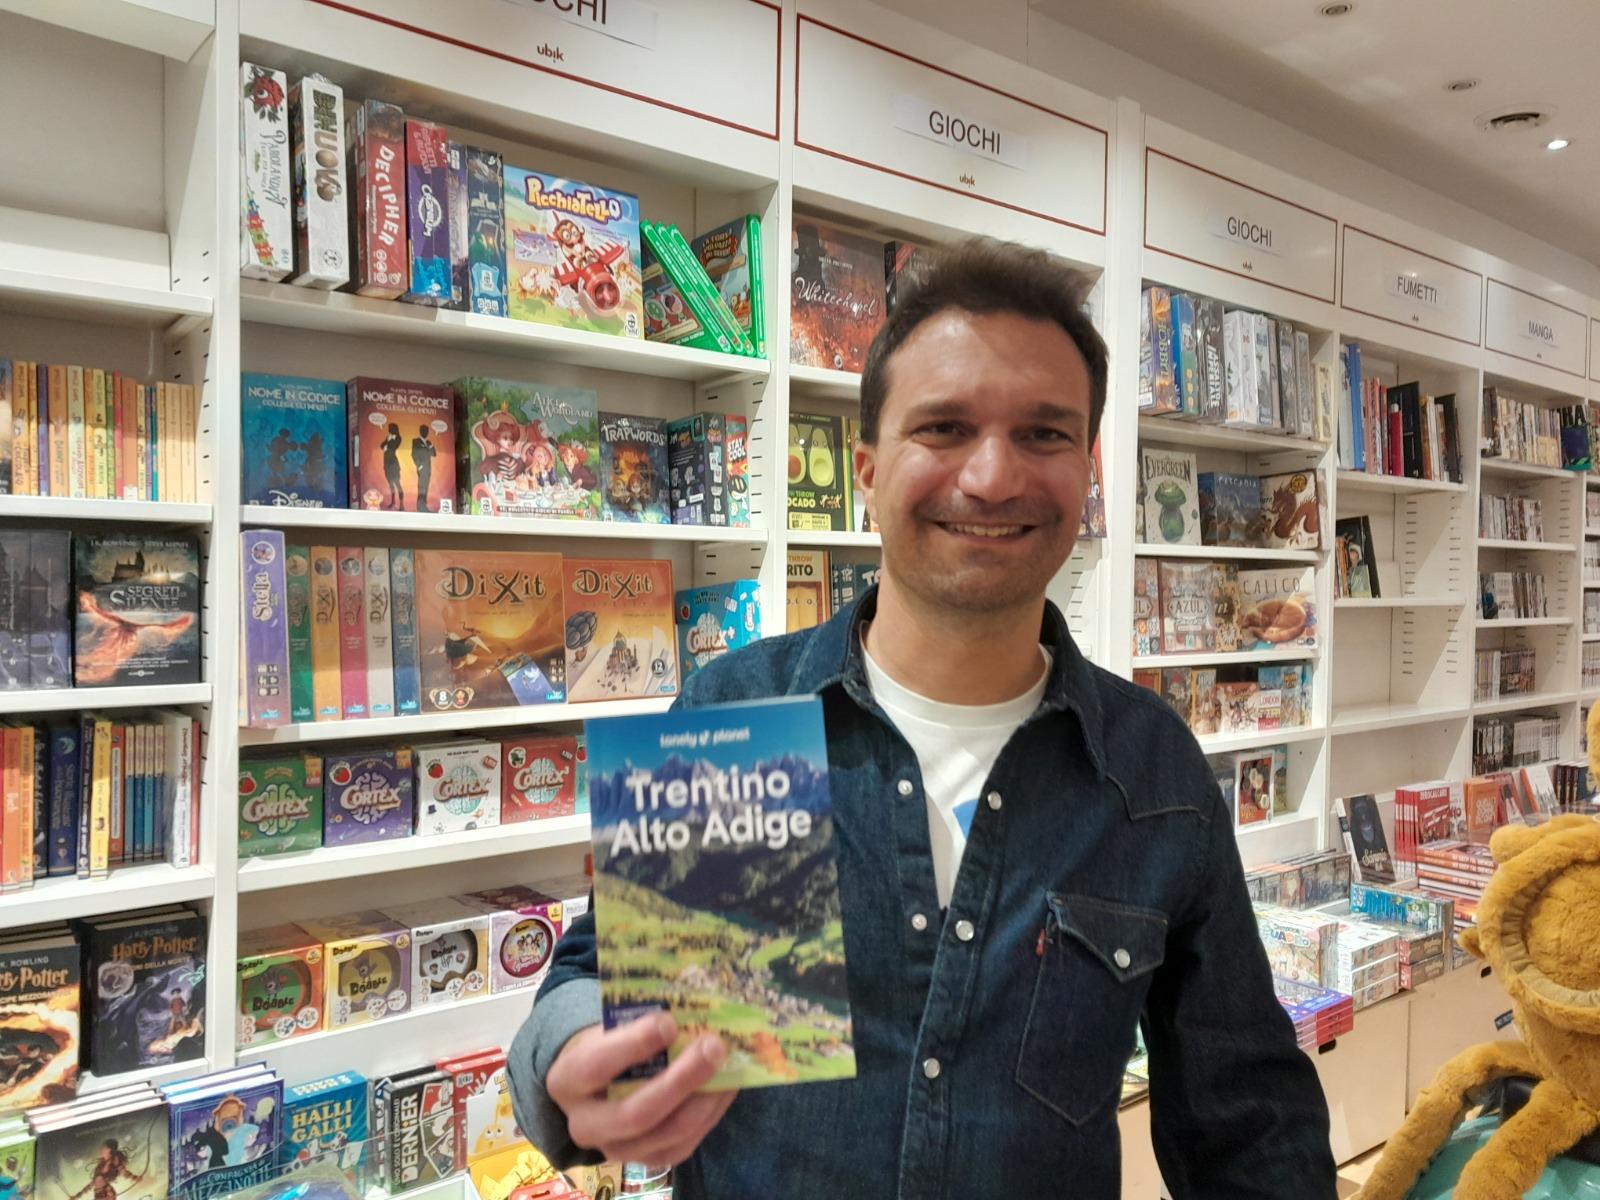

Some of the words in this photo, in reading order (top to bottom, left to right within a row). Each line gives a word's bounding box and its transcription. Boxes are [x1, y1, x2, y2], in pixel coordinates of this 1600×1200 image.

[537, 43, 564, 63] ubik
[929, 110, 1001, 155] GIOCHI
[375, 144, 400, 246] DECIPHER
[1227, 216, 1272, 248] GIOCHI
[795, 276, 876, 317] Whitechapel
[1397, 276, 1438, 305] FUMETTI
[1528, 320, 1554, 342] MANGA
[249, 387, 282, 399] NOME
[285, 391, 296, 401] IN
[299, 391, 341, 405] CODICE
[363, 391, 394, 402] NOME
[397, 394, 409, 403] IN
[411, 395, 449, 410] CODICE
[601, 421, 666, 447] TRAPWORDS
[727, 438, 743, 452] STAY
[728, 447, 746, 462] COOL
[1144, 455, 1192, 484] EVERGREEN
[787, 498, 816, 509] OCADO
[786, 564, 813, 577] RITO
[252, 571, 273, 621] Stella
[1243, 577, 1301, 595] CALICO
[1175, 601, 1203, 614] AZUL
[653, 662, 664, 672] 12
[433, 778, 488, 803] CORTEX
[514, 767, 564, 791] CORTEX
[626, 764, 791, 811] Trentino
[241, 796, 309, 824] CORTEX
[340, 785, 401, 811] CORTEX
[610, 818, 691, 858] Alto
[702, 805, 812, 849] Adige
[111, 939, 152, 961] Harry
[152, 936, 197, 957] Potter
[10, 956, 49, 967] ROWLING
[19, 967, 69, 991] Potter
[350, 976, 388, 996] DOBBLE
[253, 997, 294, 1012] DOBBLE
[292, 1099, 353, 1129] HALLI
[291, 1115, 352, 1144] GALLI
